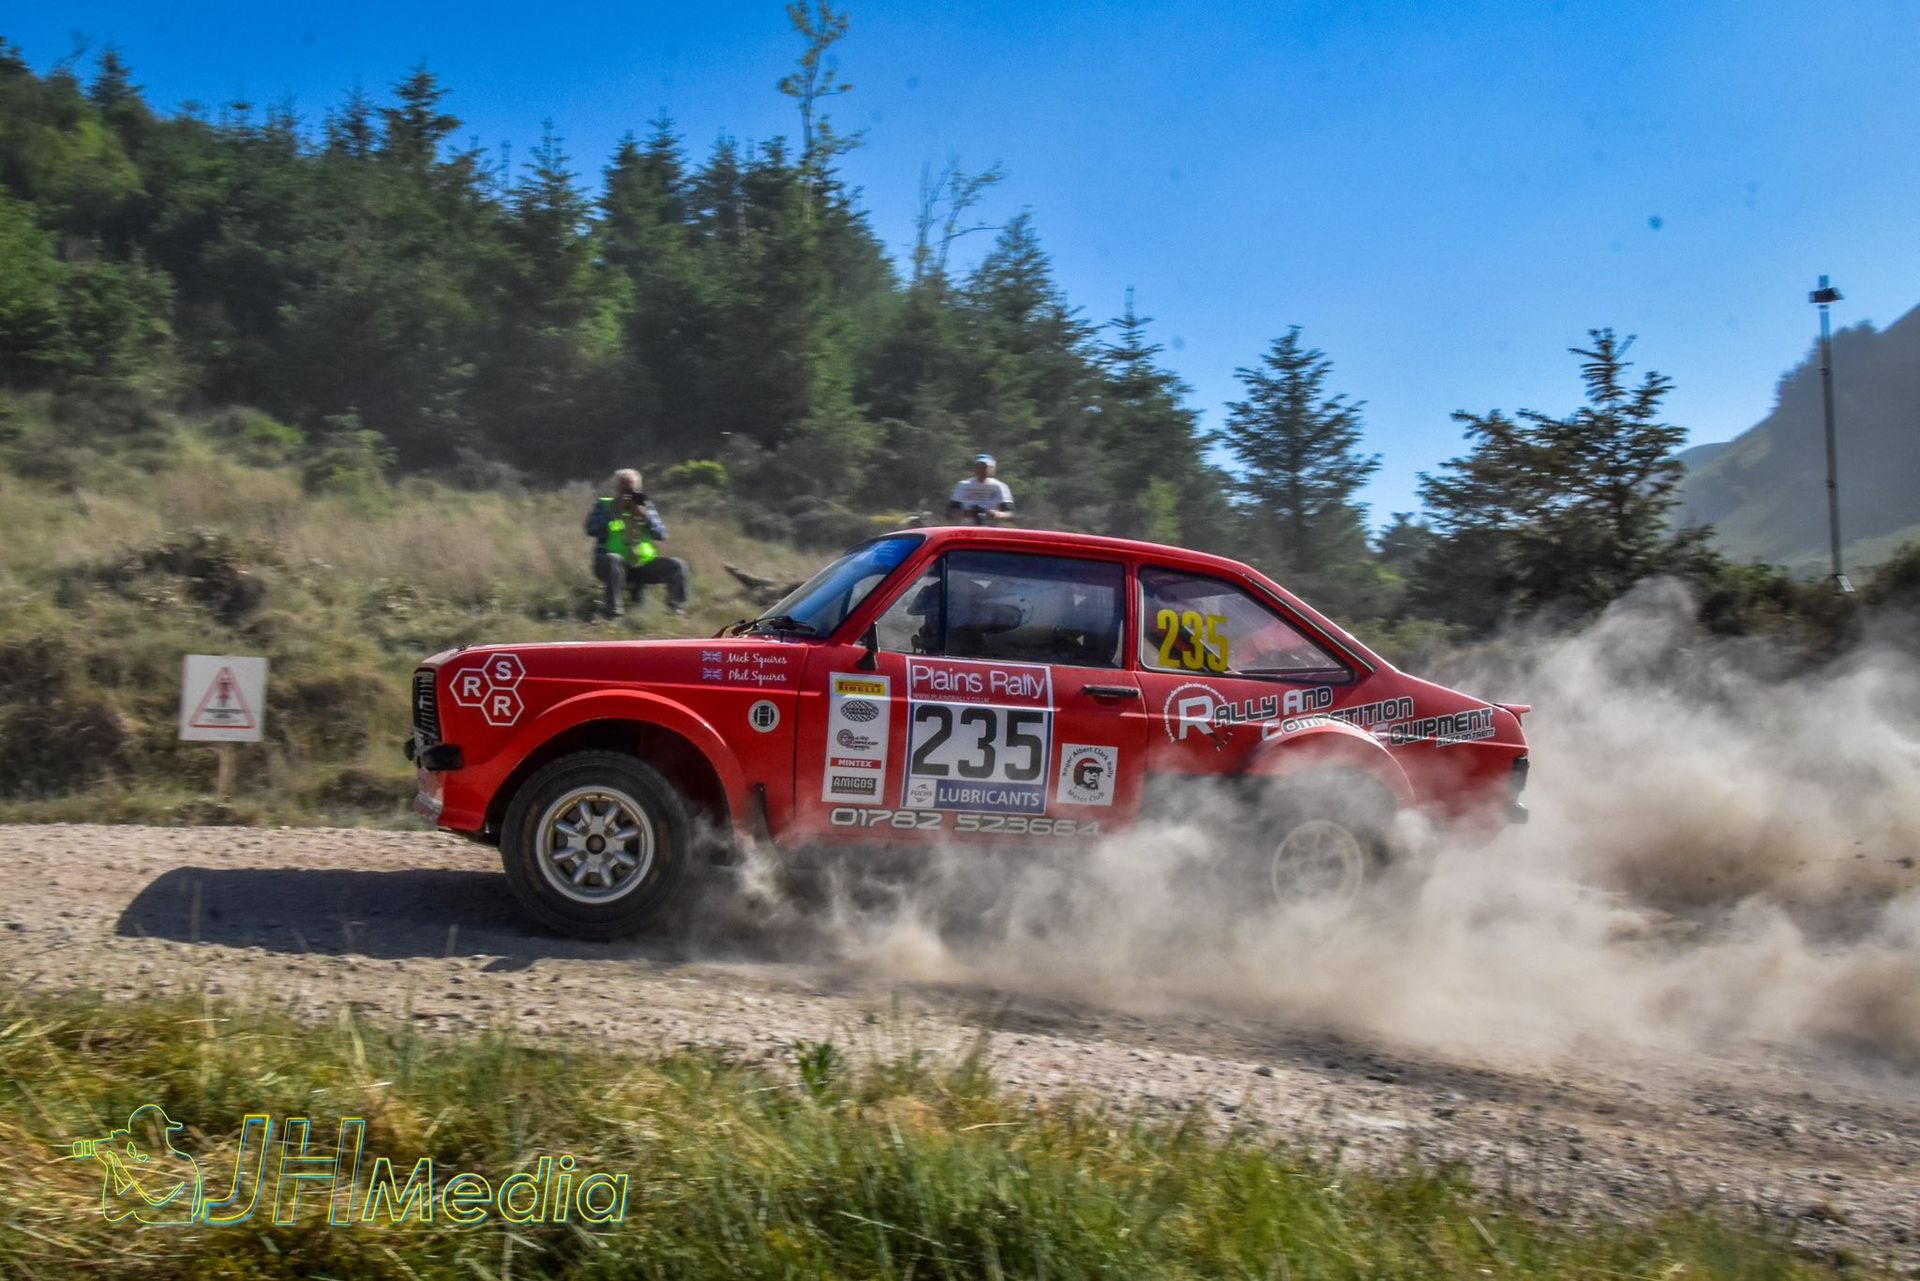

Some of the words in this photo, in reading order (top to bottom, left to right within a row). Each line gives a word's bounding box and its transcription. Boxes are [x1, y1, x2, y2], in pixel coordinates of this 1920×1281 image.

[1156, 608, 1229, 673] 235
[726, 652, 749, 663] Mick
[752, 653, 788, 669] Squires
[728, 668, 749, 681] Phil
[751, 670, 787, 687] Squires
[912, 664, 983, 693] Plains
[989, 669, 1045, 699] Rally
[911, 705, 1044, 781] 235
[838, 759, 873, 768] MINTEX
[833, 777, 874, 789] AMIGOS
[938, 787, 1041, 807] LUBRICANTS
[830, 807, 943, 831] 01782
[954, 814, 1100, 836] 523664
